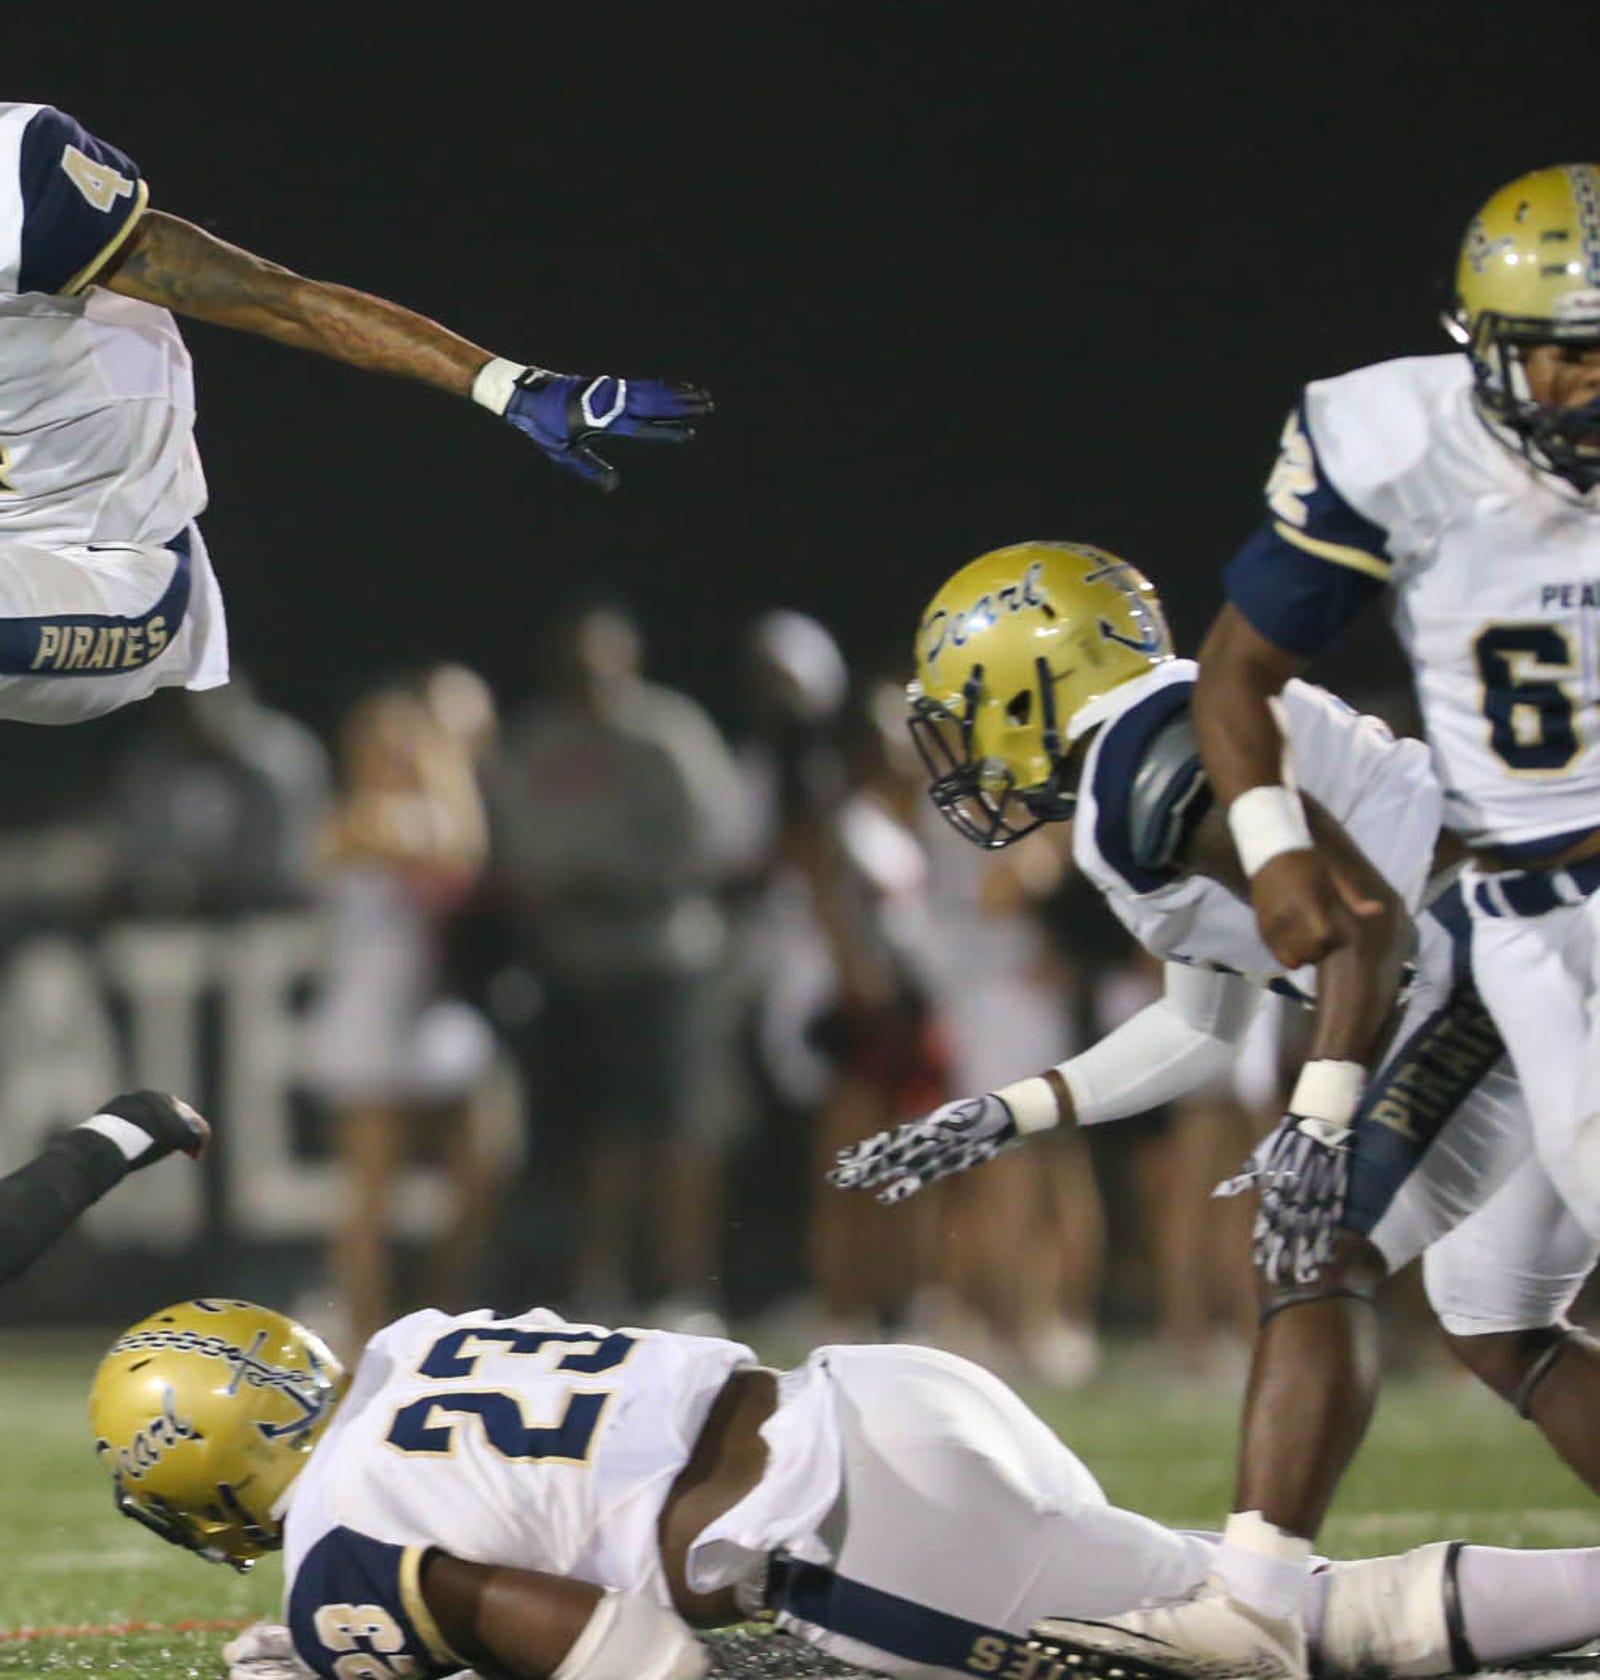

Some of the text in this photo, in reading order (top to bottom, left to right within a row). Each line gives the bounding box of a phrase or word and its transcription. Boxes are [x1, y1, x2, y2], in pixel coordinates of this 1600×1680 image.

[60, 143, 135, 214] 4
[1540, 582, 1600, 610] PEA
[30, 615, 168, 670] PIRATES
[1471, 617, 1590, 779] 6
[380, 1326, 639, 1467] 23
